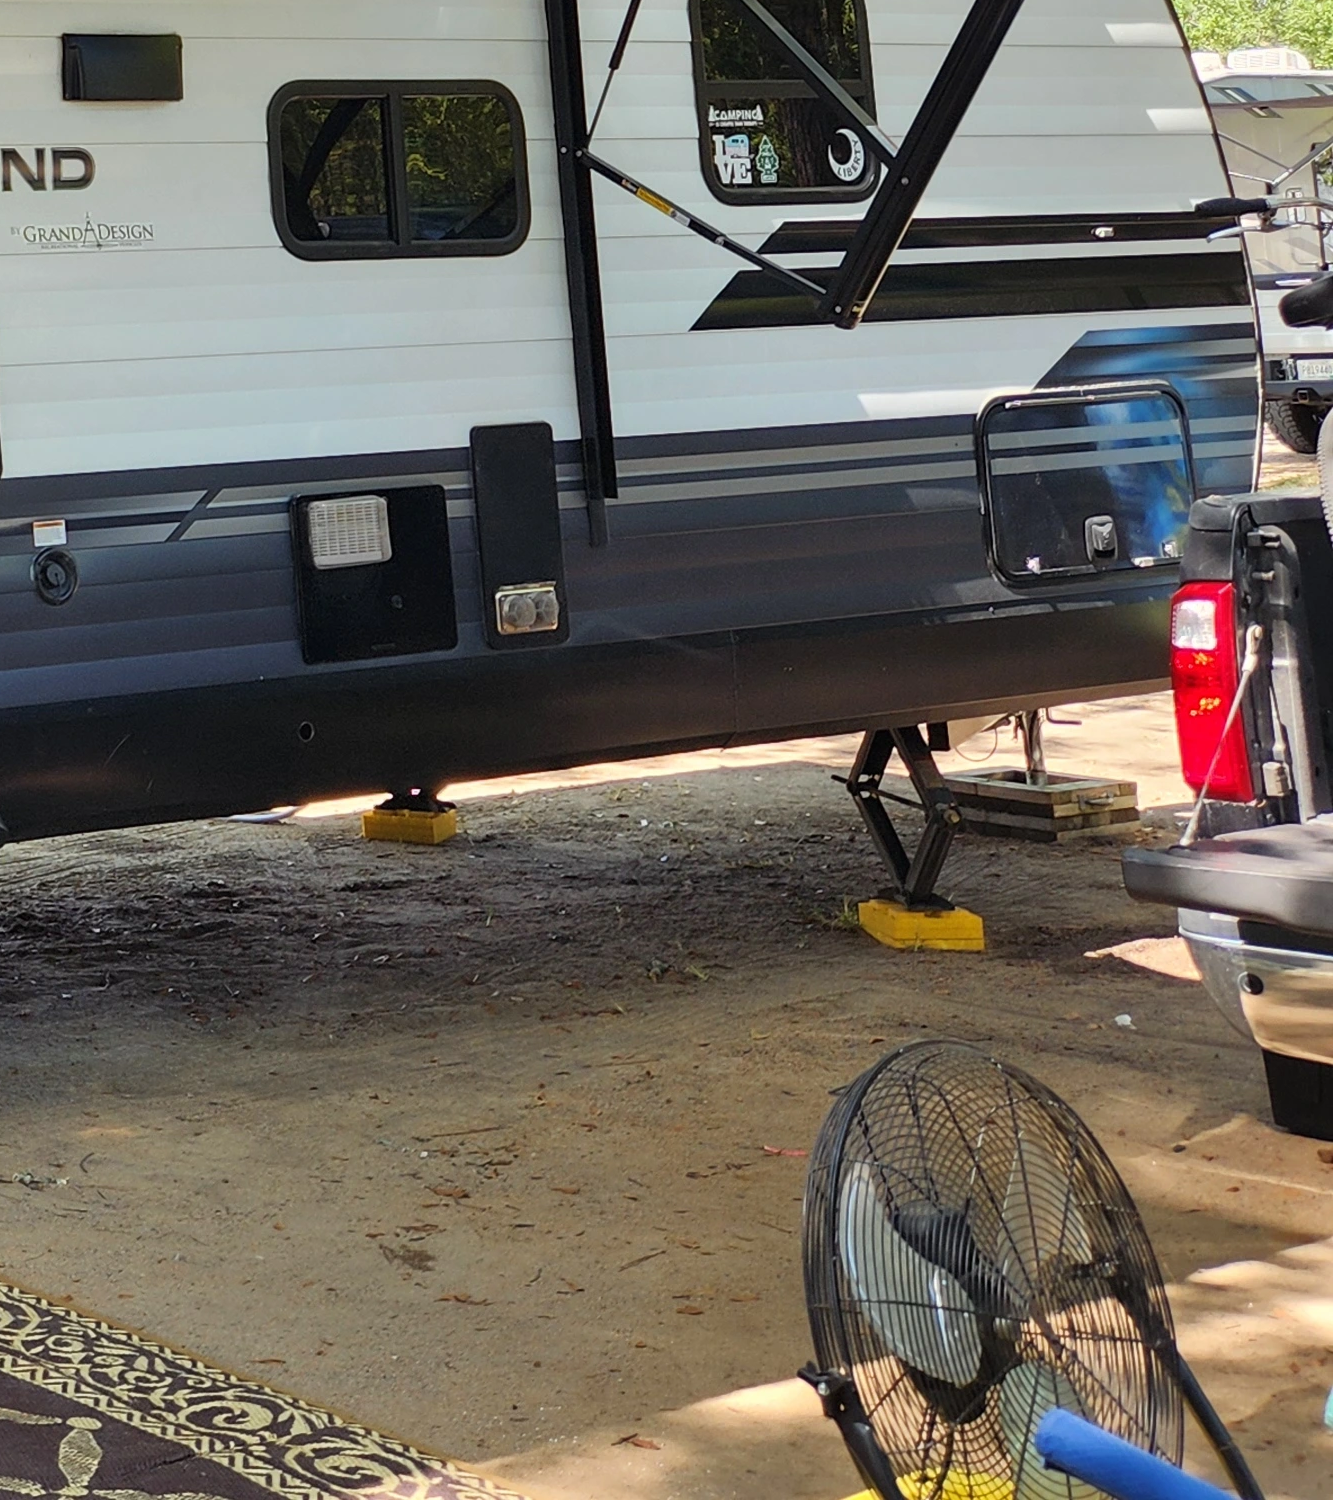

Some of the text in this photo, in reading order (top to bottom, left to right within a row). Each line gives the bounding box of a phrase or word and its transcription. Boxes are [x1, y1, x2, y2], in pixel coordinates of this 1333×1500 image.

[837, 139, 861, 178] LIBERTY
[23, 225, 83, 243] GRAND
[96, 223, 154, 241] DESIGN
